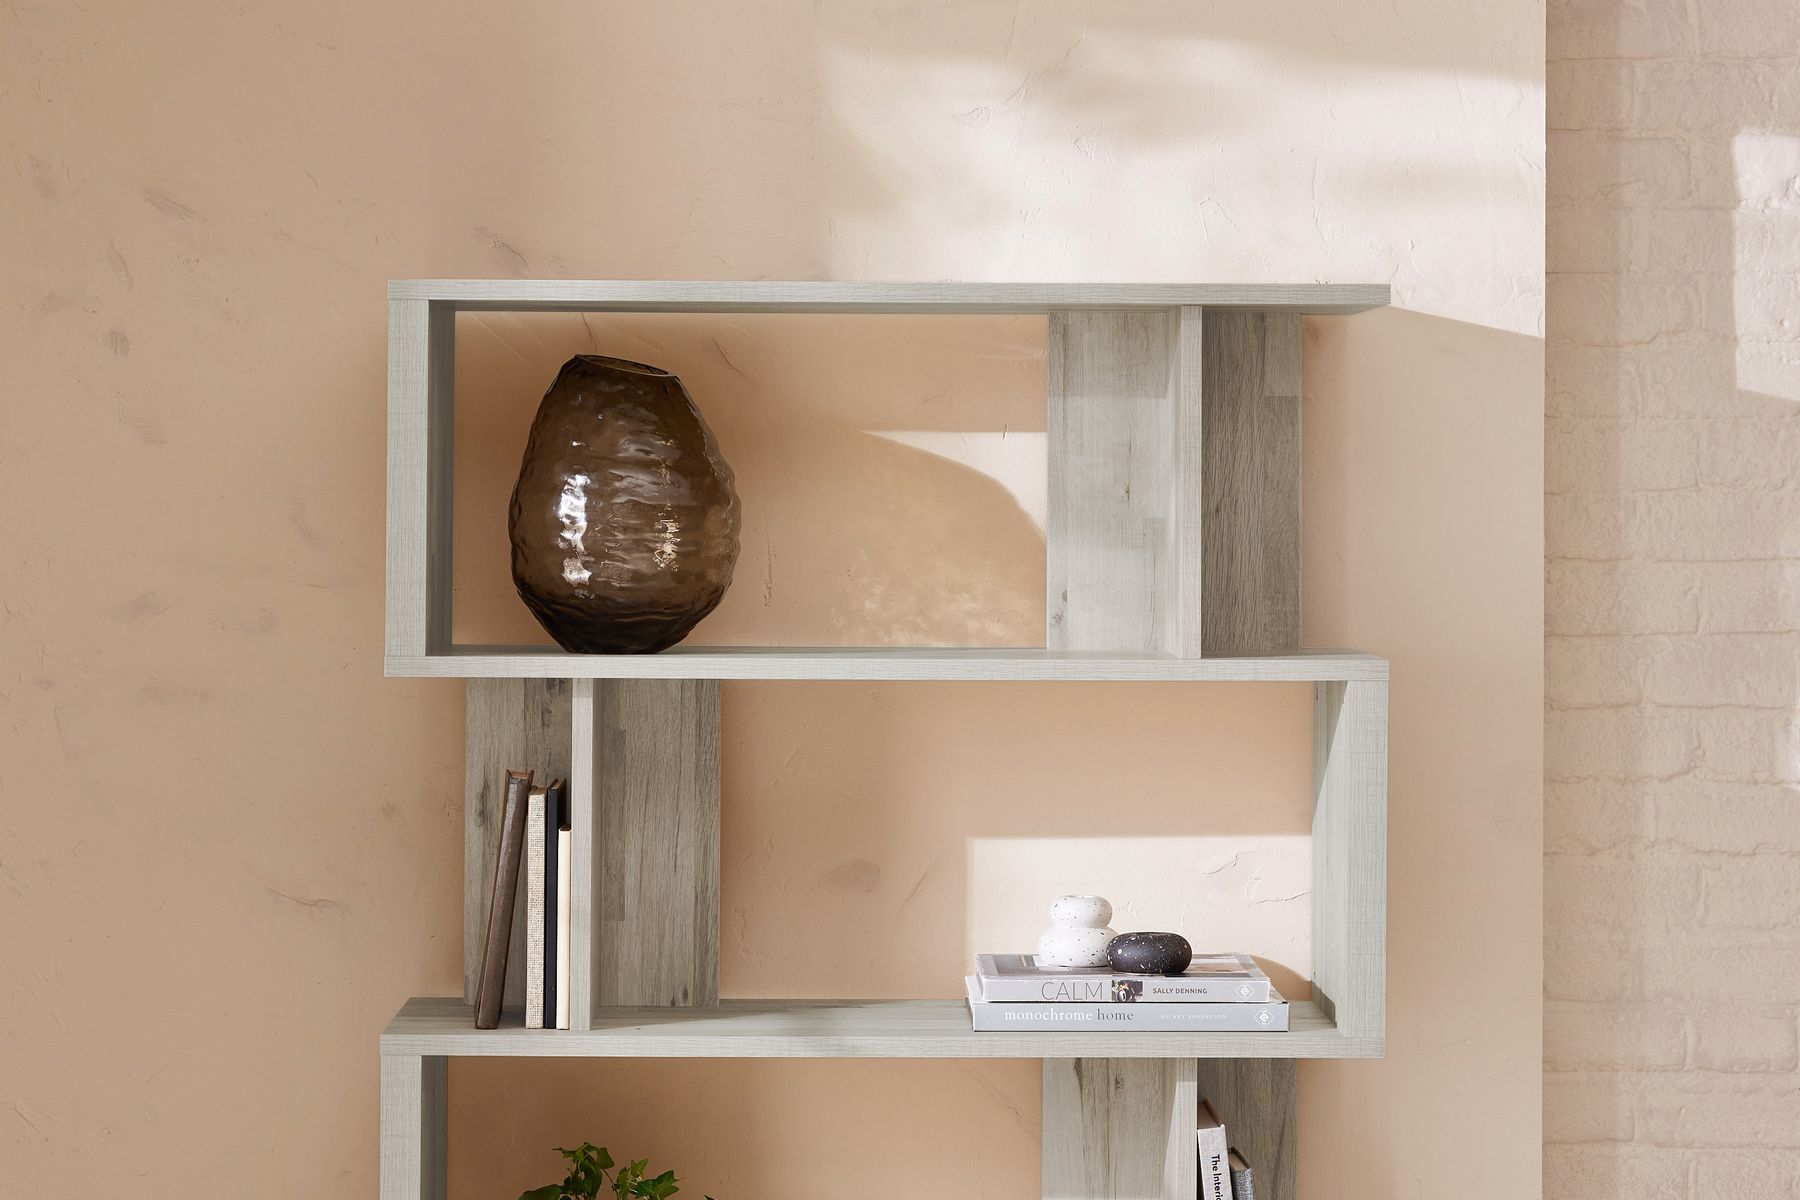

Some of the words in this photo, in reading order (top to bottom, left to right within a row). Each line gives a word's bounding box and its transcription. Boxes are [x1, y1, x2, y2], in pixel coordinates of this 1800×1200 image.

[1041, 981, 1103, 1000] CALM
[1004, 1007, 1093, 1021] monochrome
[1097, 1008, 1134, 1021] home
[1211, 1154, 1221, 1172] The
